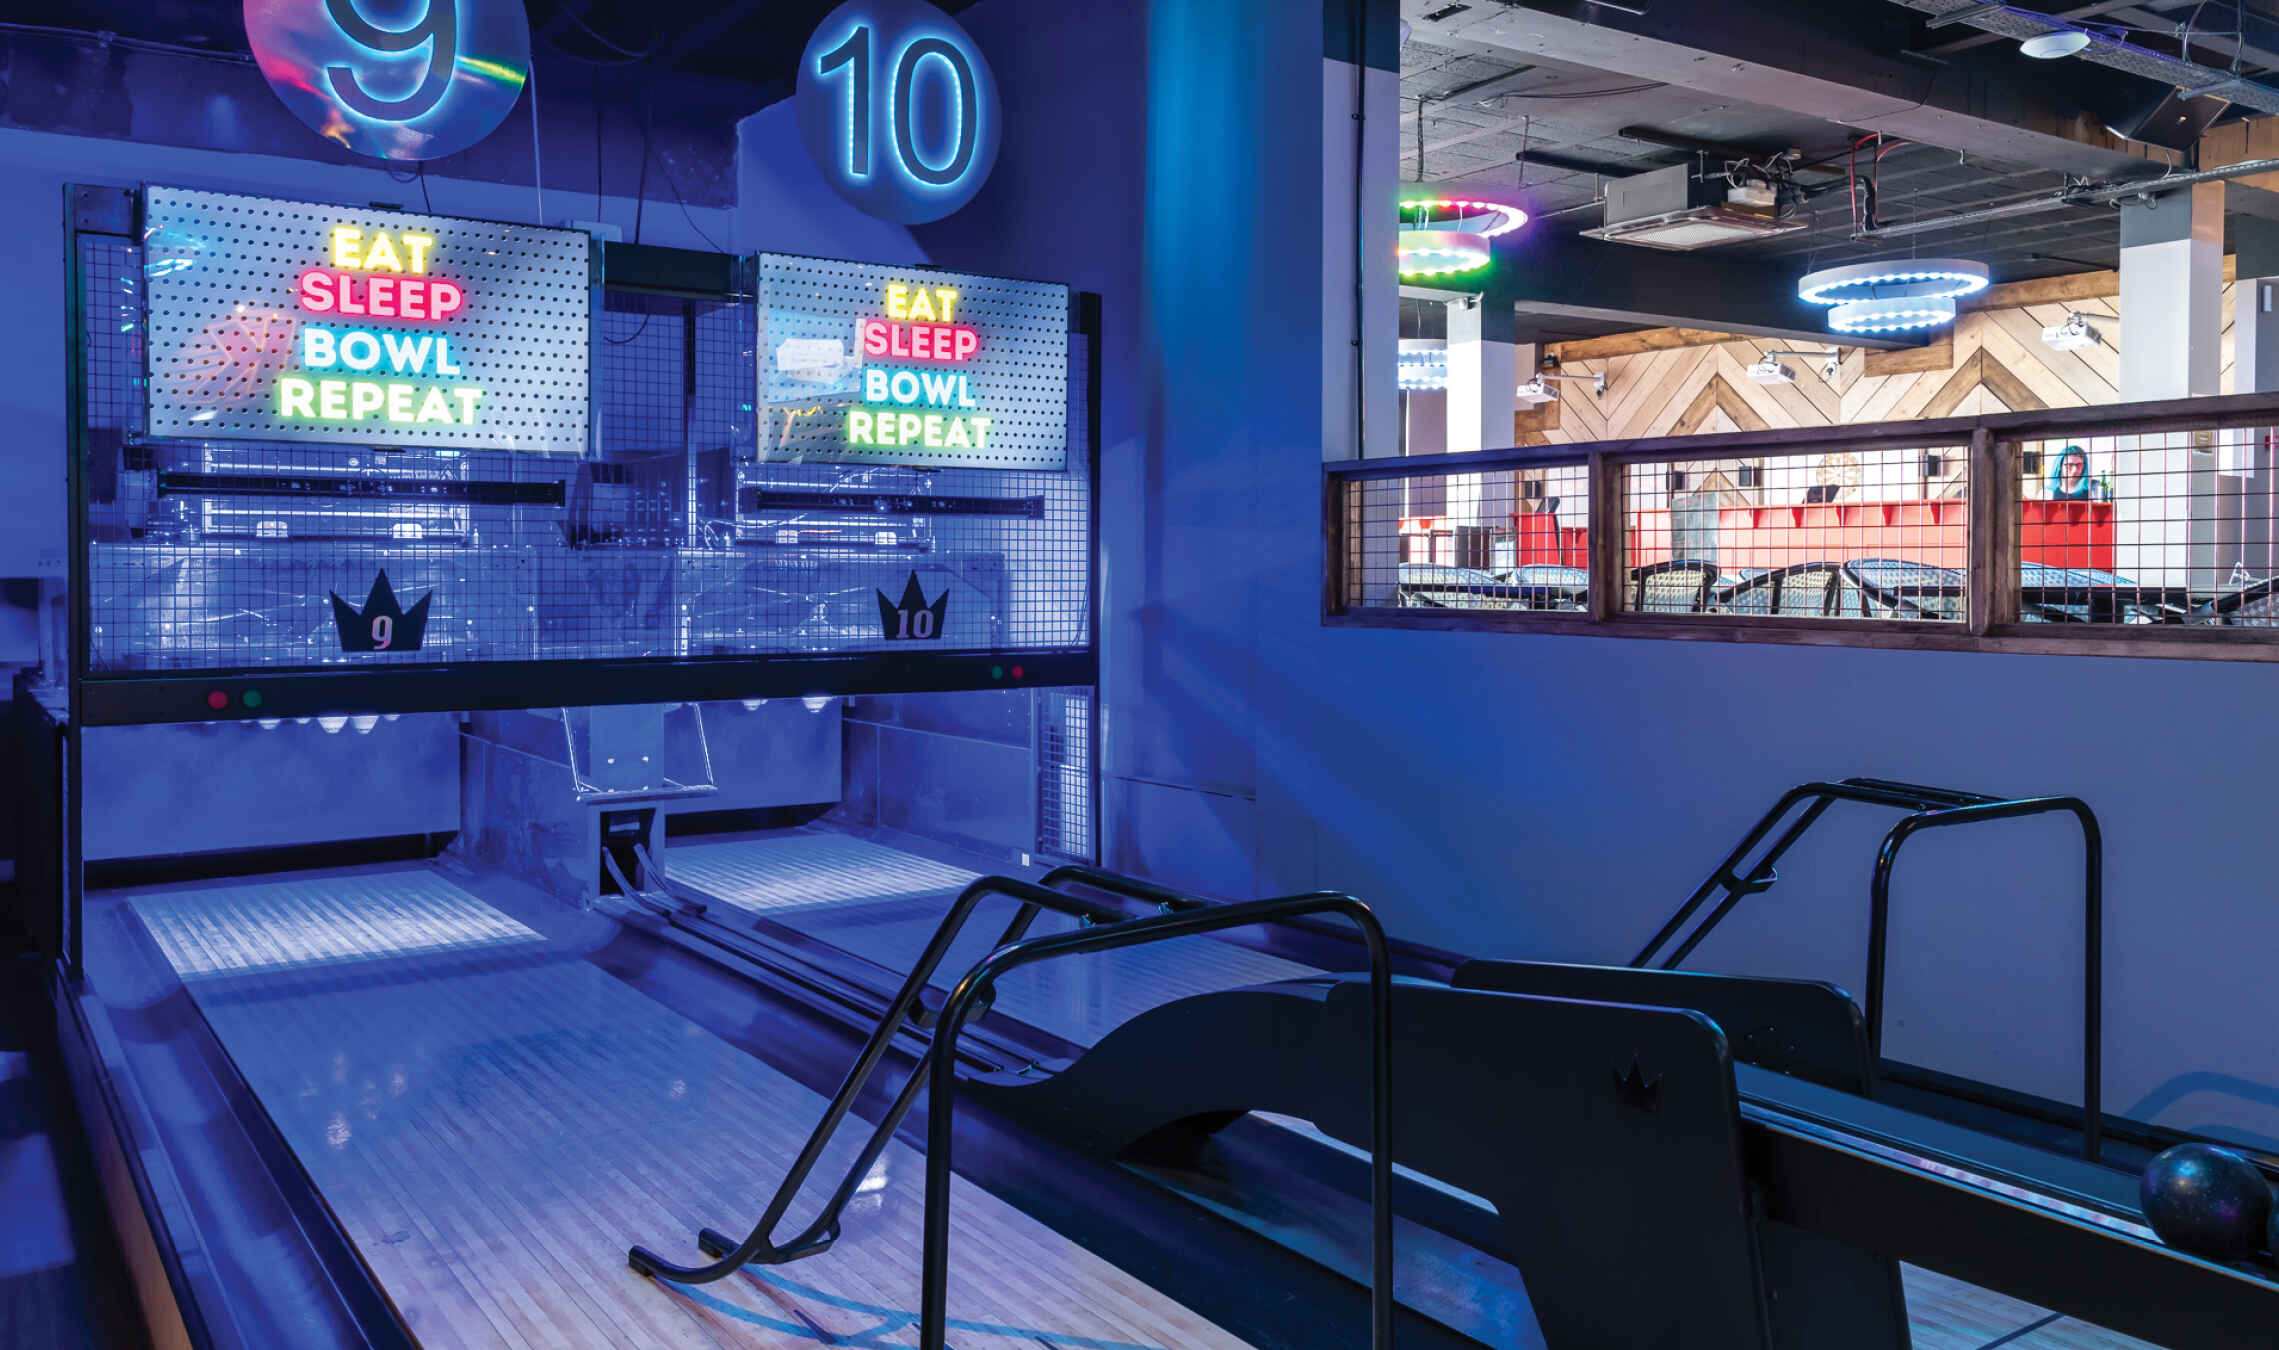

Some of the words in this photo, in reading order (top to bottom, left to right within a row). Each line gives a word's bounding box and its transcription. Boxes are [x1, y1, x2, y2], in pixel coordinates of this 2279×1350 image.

[324, 0, 458, 122] 9
[818, 25, 979, 187] 10
[333, 227, 433, 273] EAT
[301, 271, 464, 321] SLEEP
[887, 284, 958, 322] EAT
[304, 327, 461, 376] BOWL
[864, 321, 978, 361] SLEEP
[280, 377, 484, 425] REPEAT
[866, 368, 977, 408] BOWL
[849, 410, 992, 449] REPEAT
[372, 615, 393, 650] 9
[896, 609, 934, 639] 10
